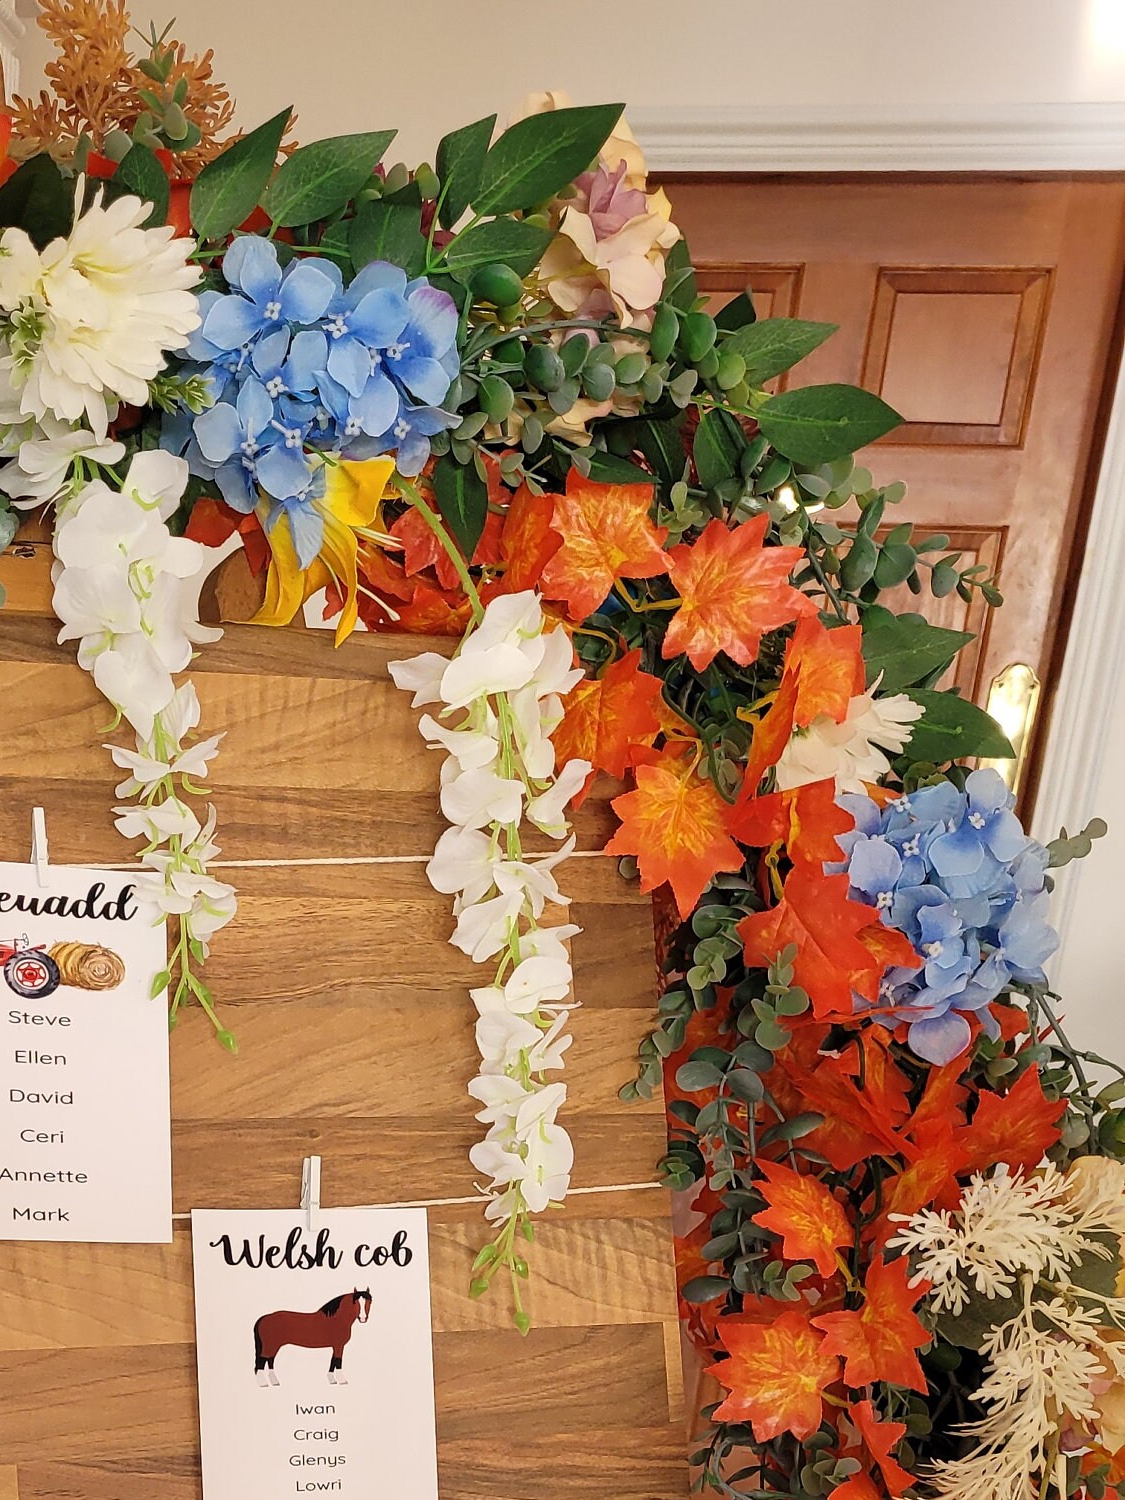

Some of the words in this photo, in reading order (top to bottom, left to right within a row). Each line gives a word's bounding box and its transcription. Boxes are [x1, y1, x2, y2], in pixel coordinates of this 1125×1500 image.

[8, 1010, 71, 1027] Steve
[15, 1050, 67, 1066] Ellen
[9, 1089, 74, 1105] David
[20, 1129, 64, 1144] Ceri
[12, 1207, 70, 1222] Mark
[209, 1226, 344, 1270] Welsh
[354, 1230, 413, 1268] cob
[295, 1403, 336, 1415] Iwan
[293, 1428, 339, 1442] Craig
[289, 1454, 346, 1468] Glenys
[296, 1478, 342, 1492] Lowri
